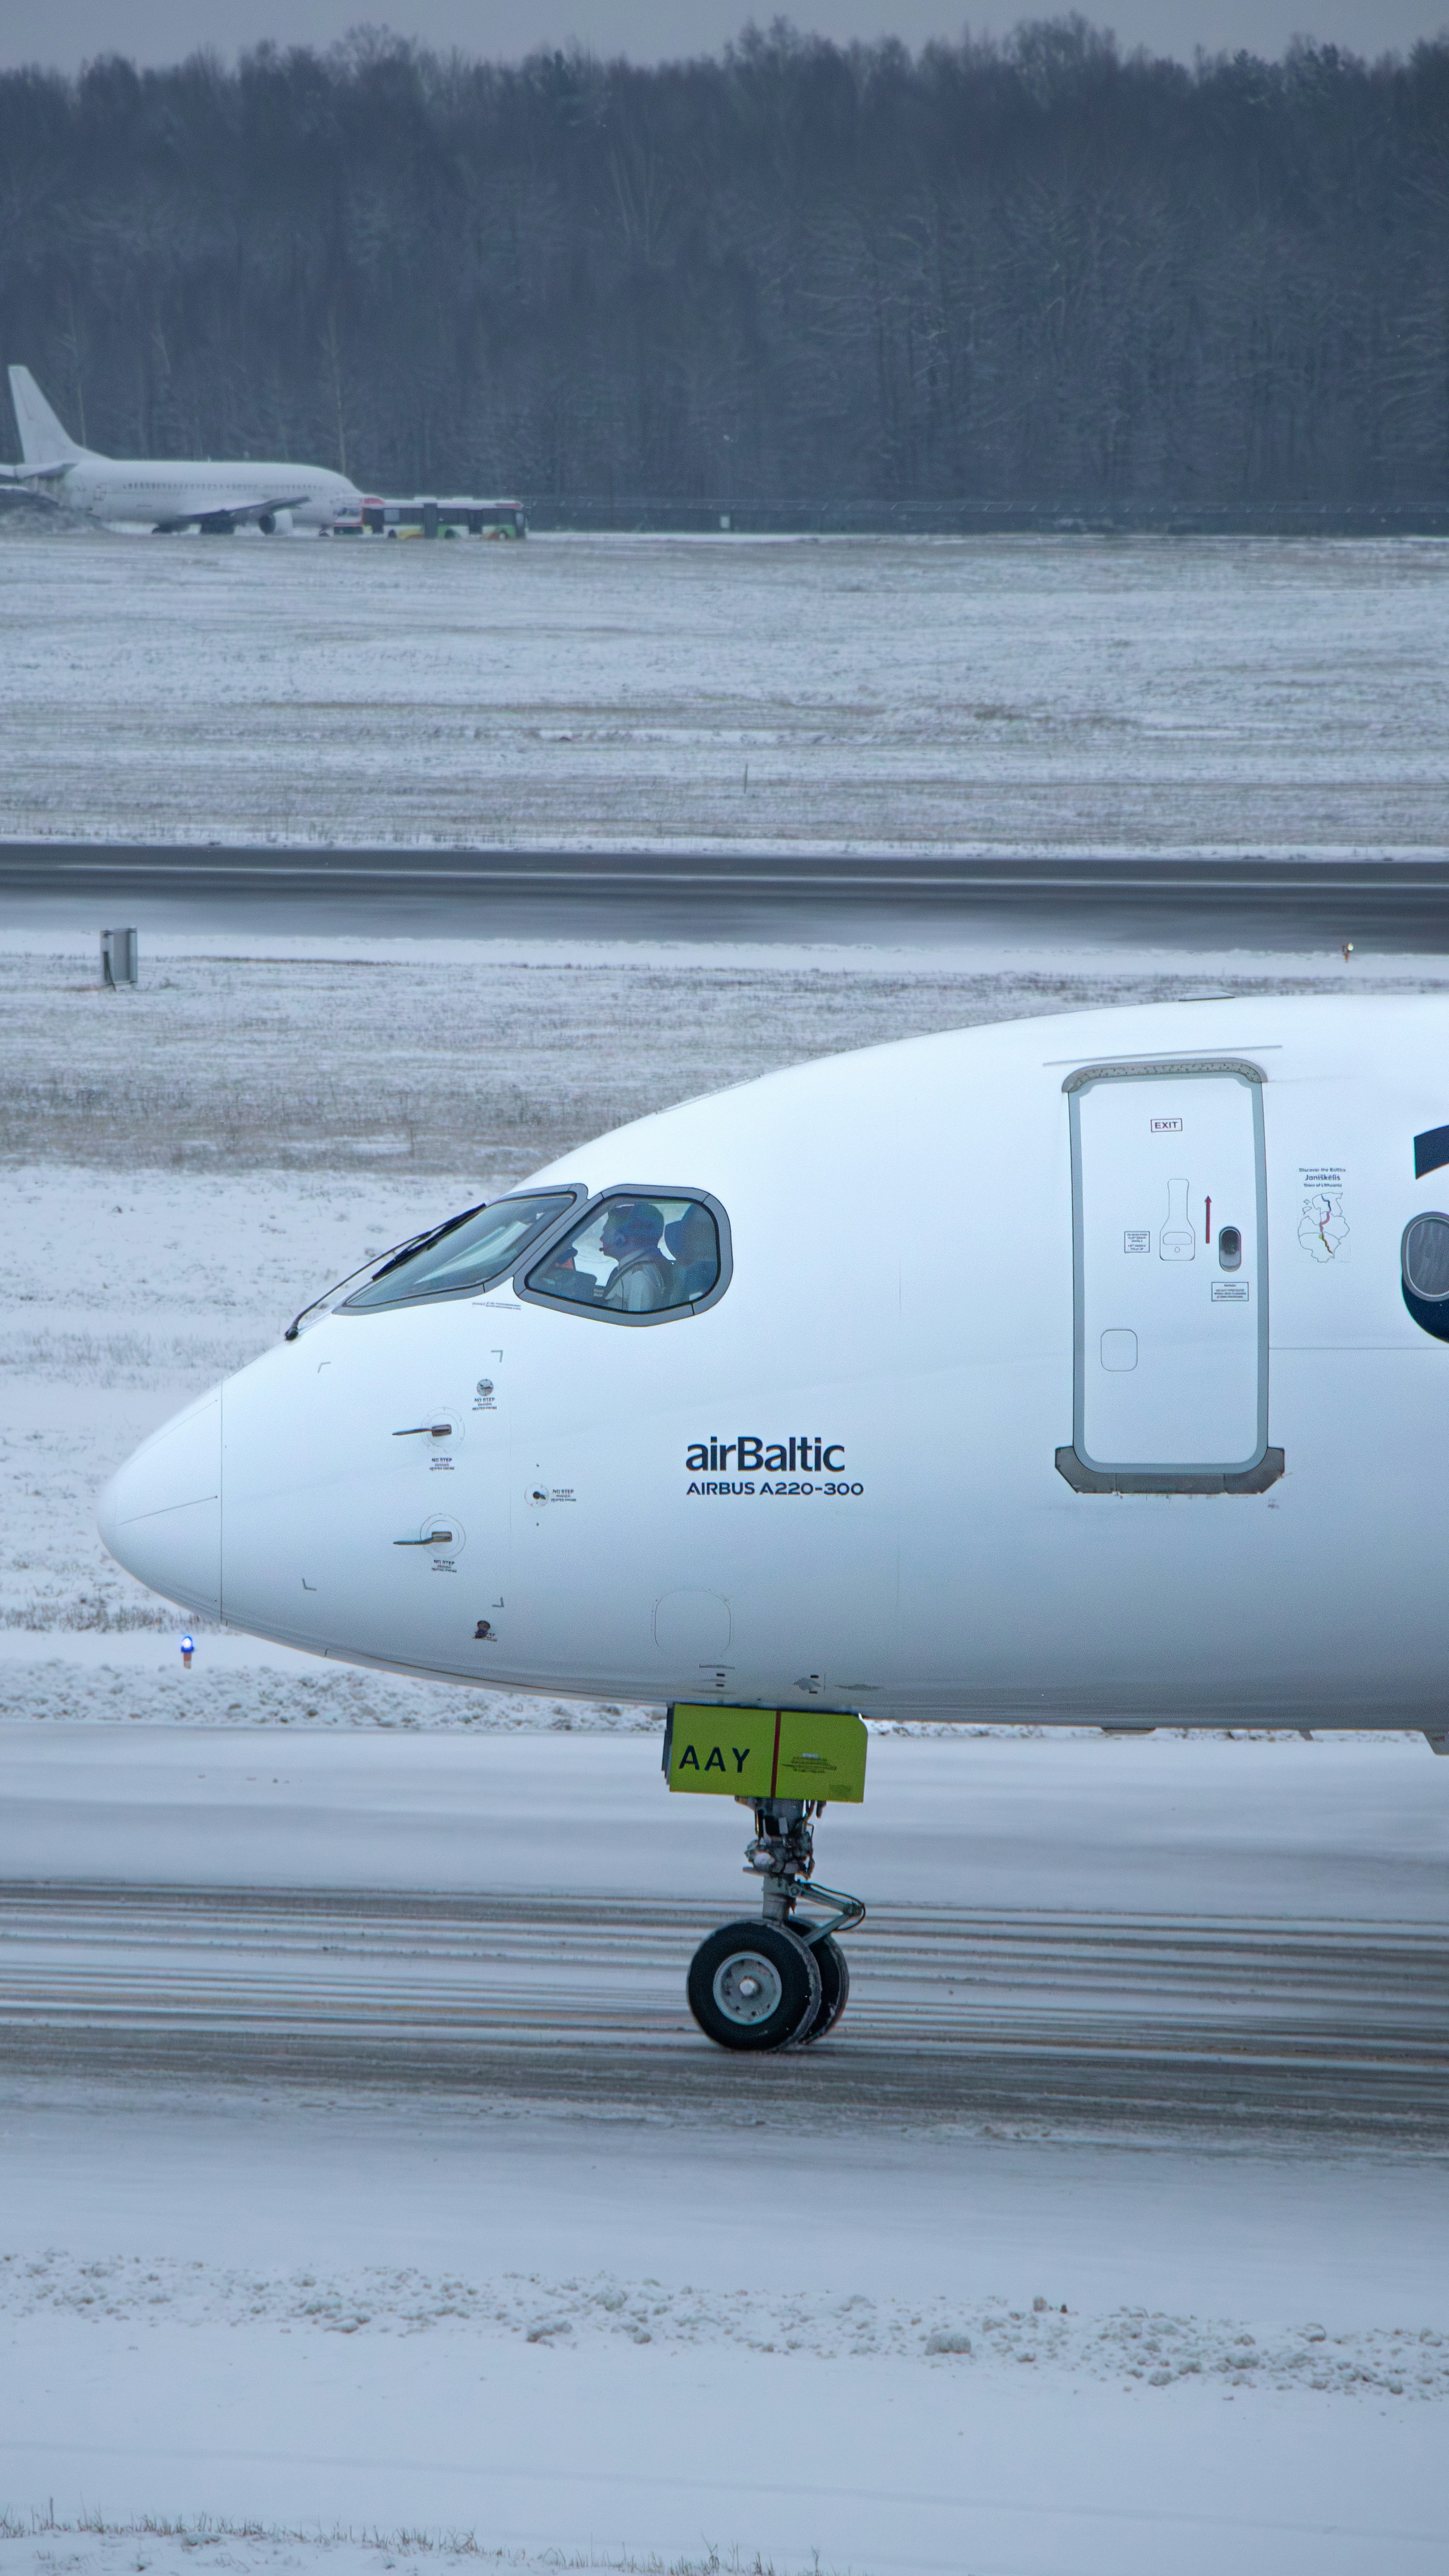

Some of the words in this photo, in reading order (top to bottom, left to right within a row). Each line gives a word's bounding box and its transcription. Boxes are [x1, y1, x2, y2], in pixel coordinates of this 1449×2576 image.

[686, 1436, 845, 1472] airBaltic
[686, 1482, 755, 1495] AIRBUS
[760, 1482, 864, 1496] A220-300
[679, 1745, 750, 1773] AAY
